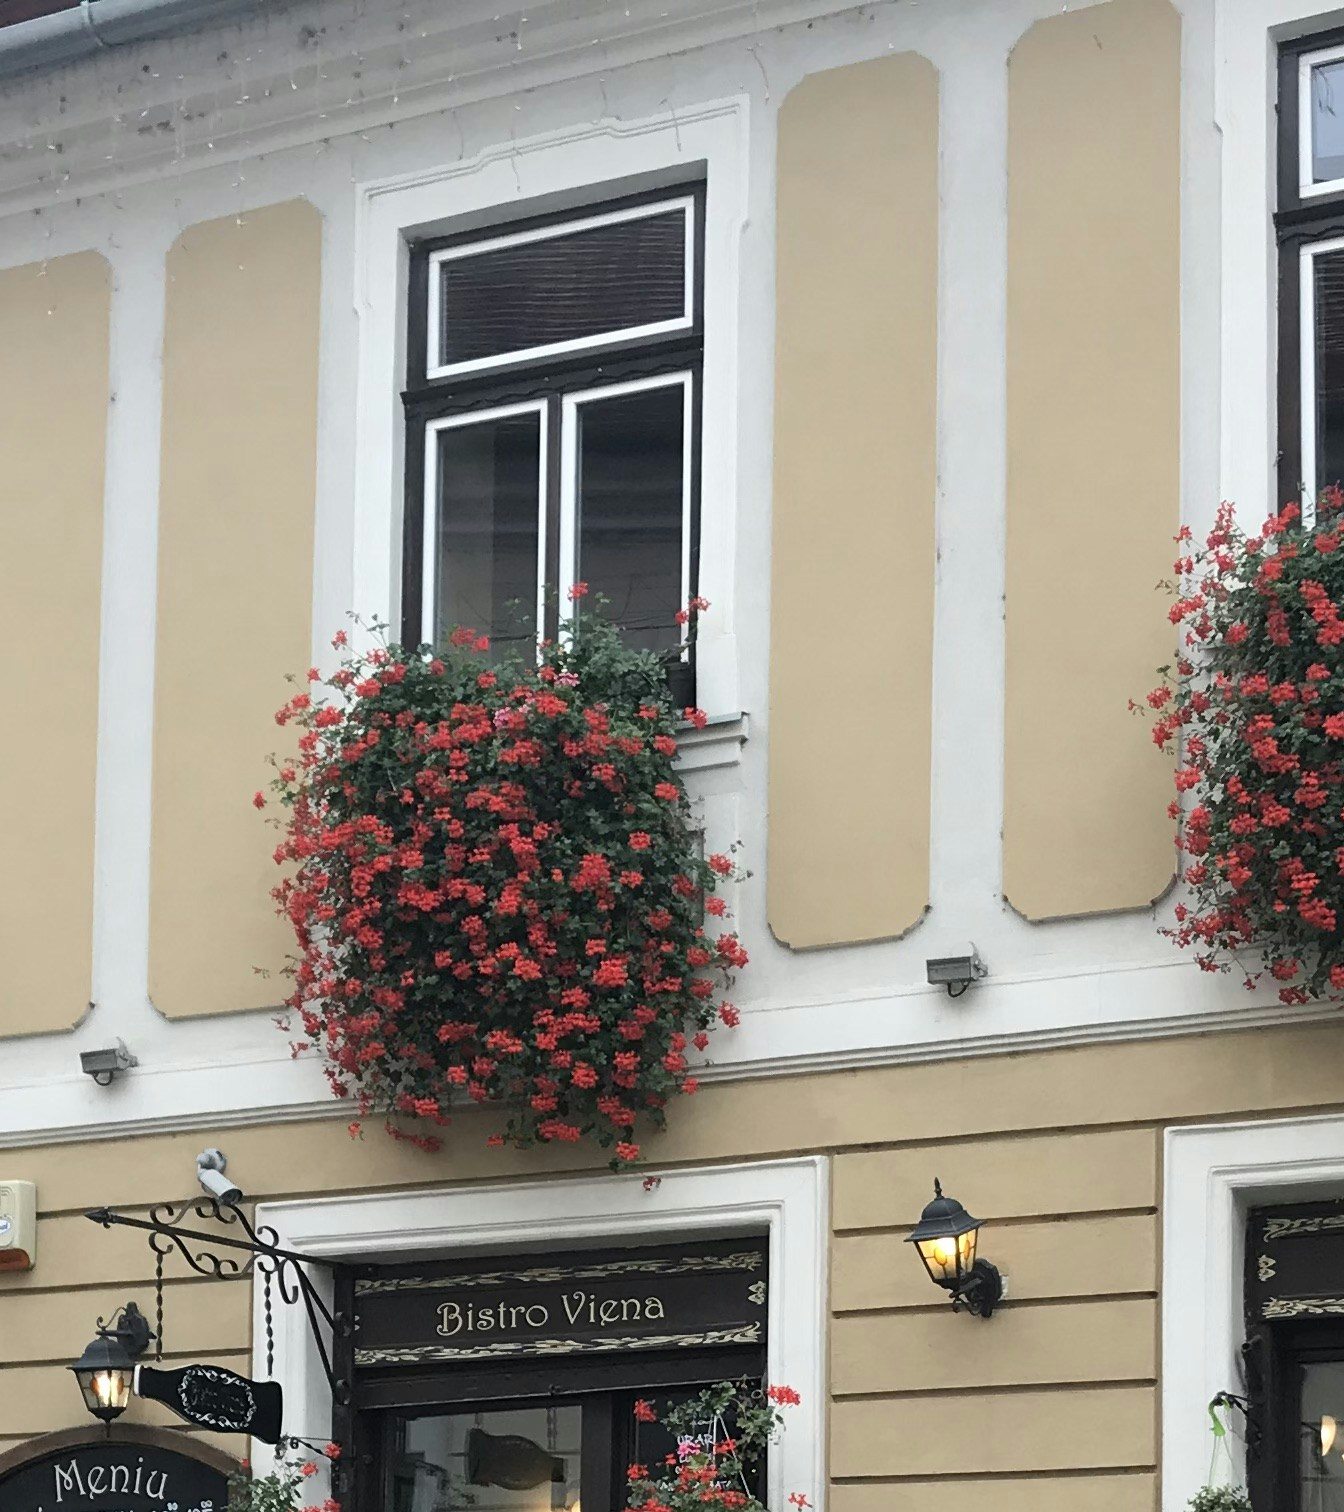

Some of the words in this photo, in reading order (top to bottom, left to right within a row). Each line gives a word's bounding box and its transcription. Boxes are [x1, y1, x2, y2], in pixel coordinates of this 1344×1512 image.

[435, 1301, 548, 1337] Bistro
[561, 1291, 665, 1326] Viena
[54, 1456, 168, 1502] Meniu
